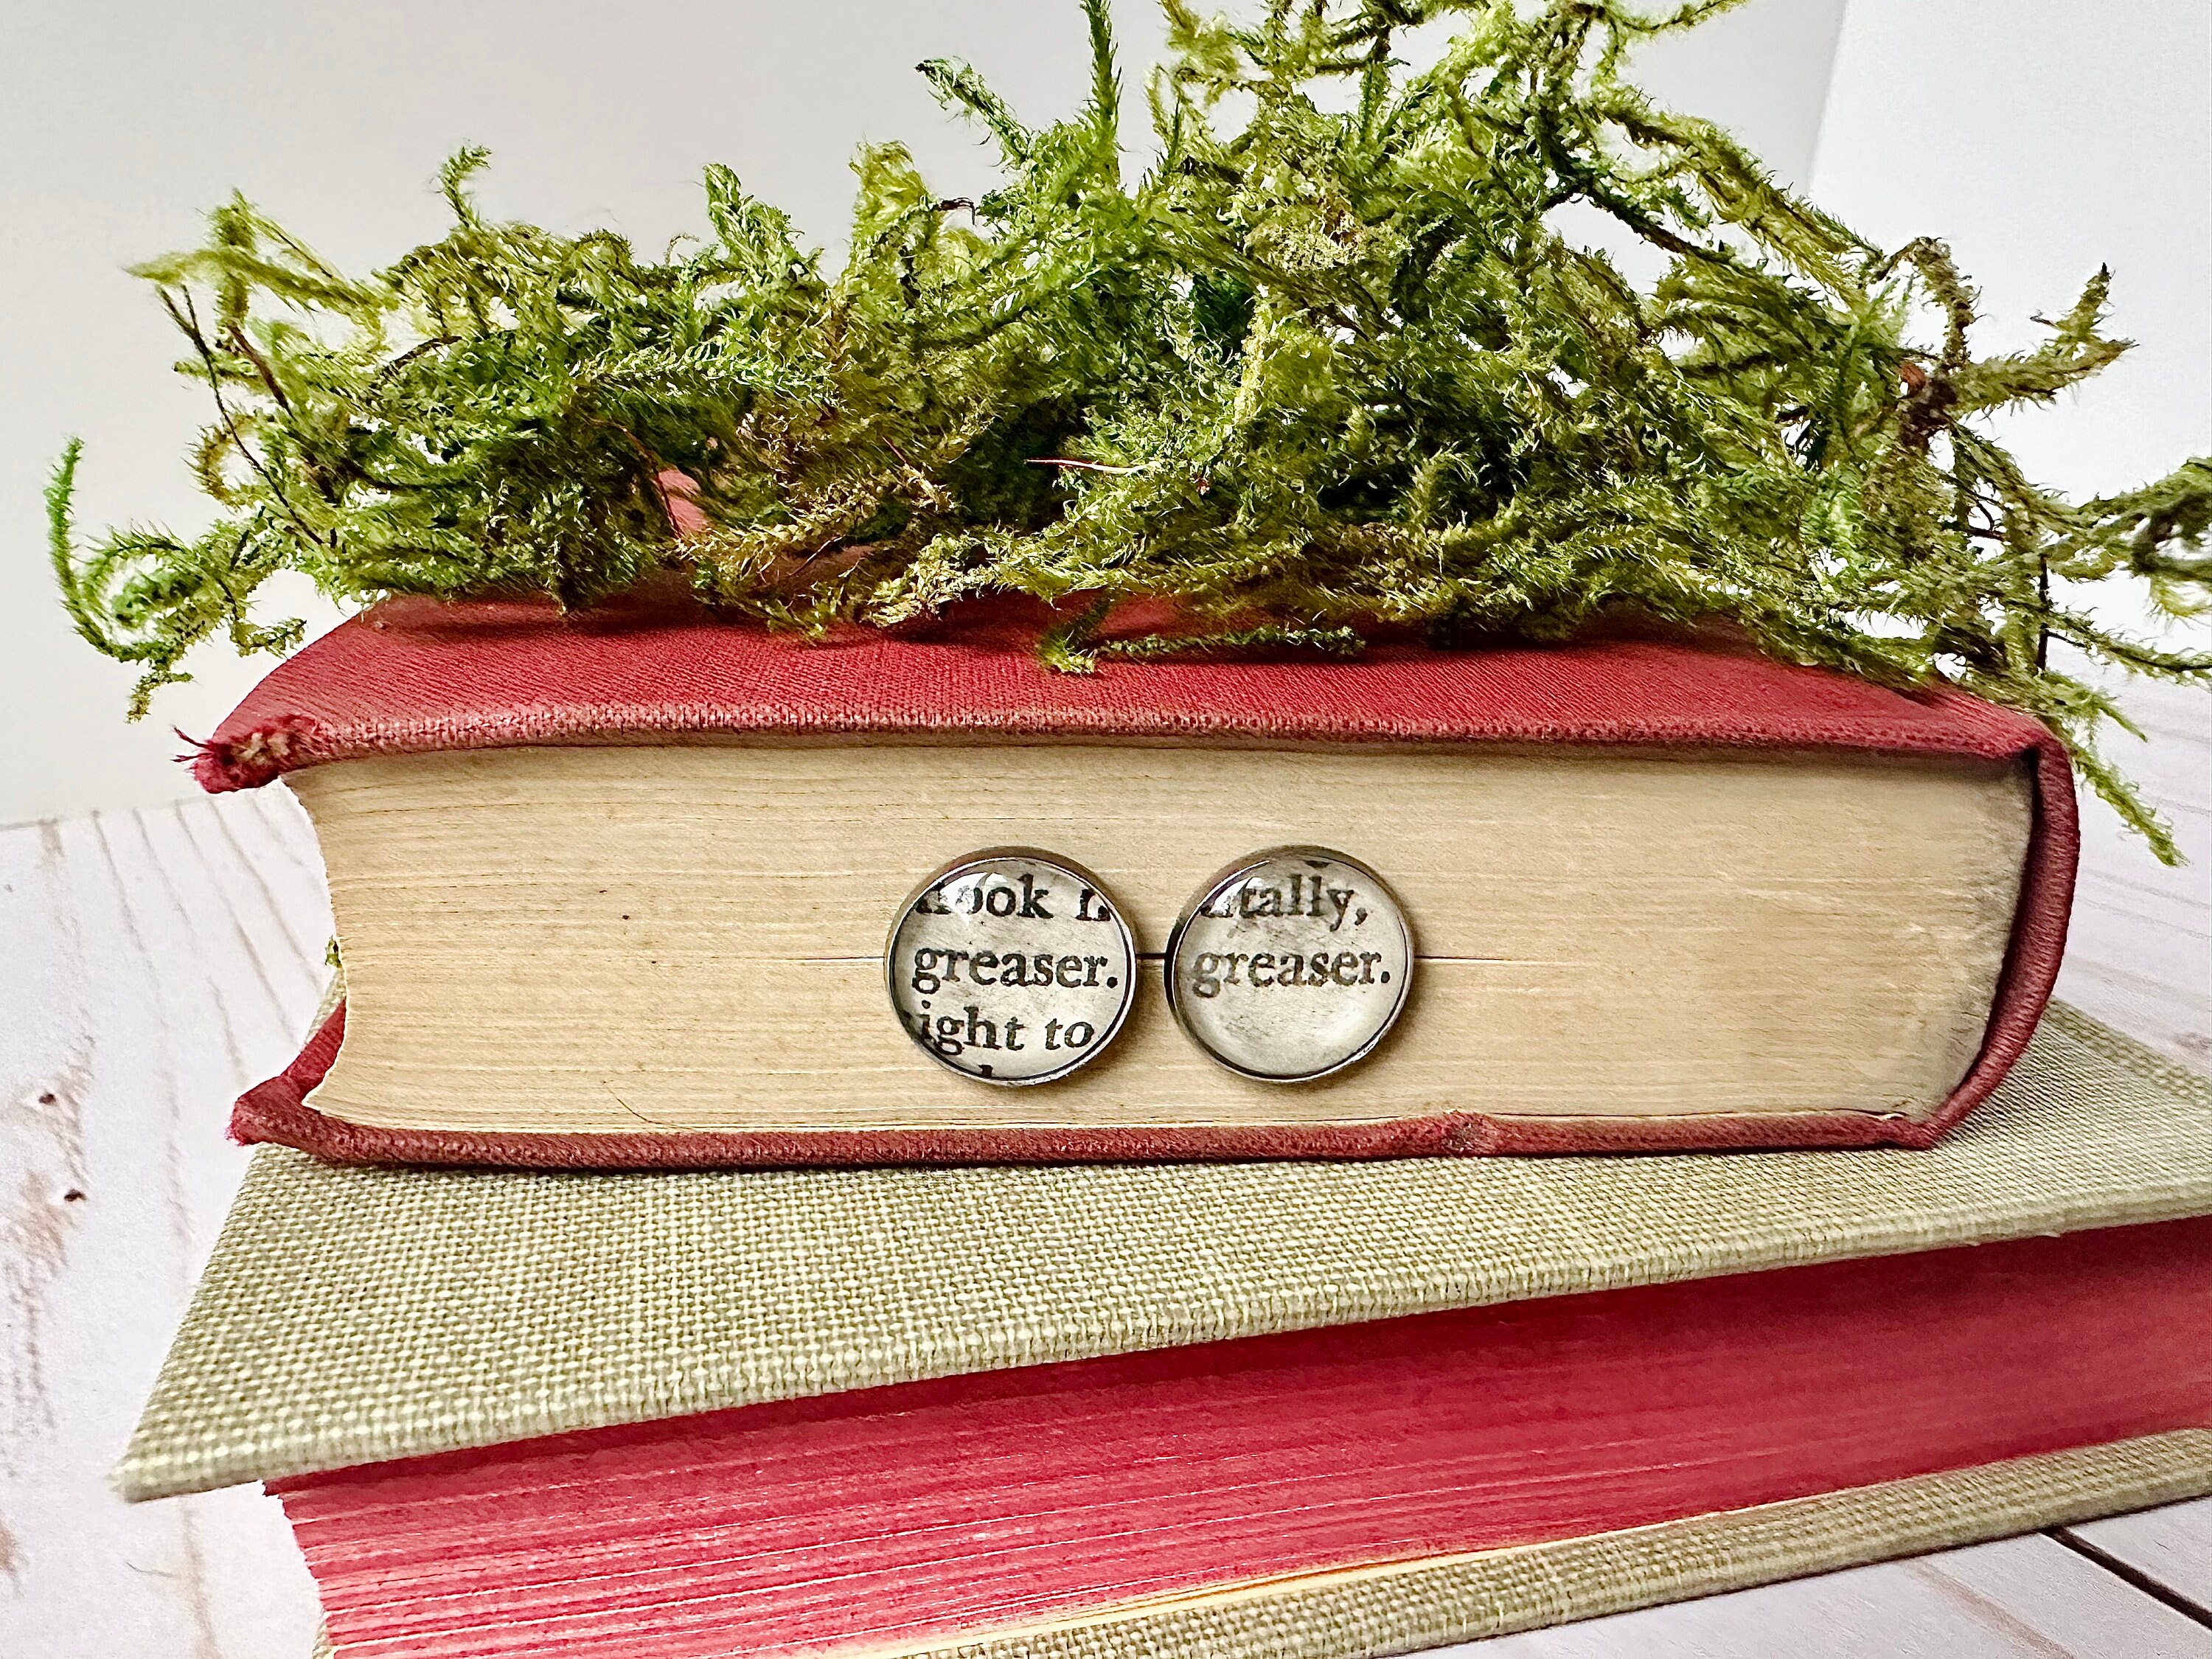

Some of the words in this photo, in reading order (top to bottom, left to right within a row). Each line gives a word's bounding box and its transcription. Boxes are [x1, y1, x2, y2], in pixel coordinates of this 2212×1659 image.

[911, 947, 1119, 995] greaser.
[1192, 952, 1391, 998] greaser.
[1045, 1018, 1096, 1051] to
